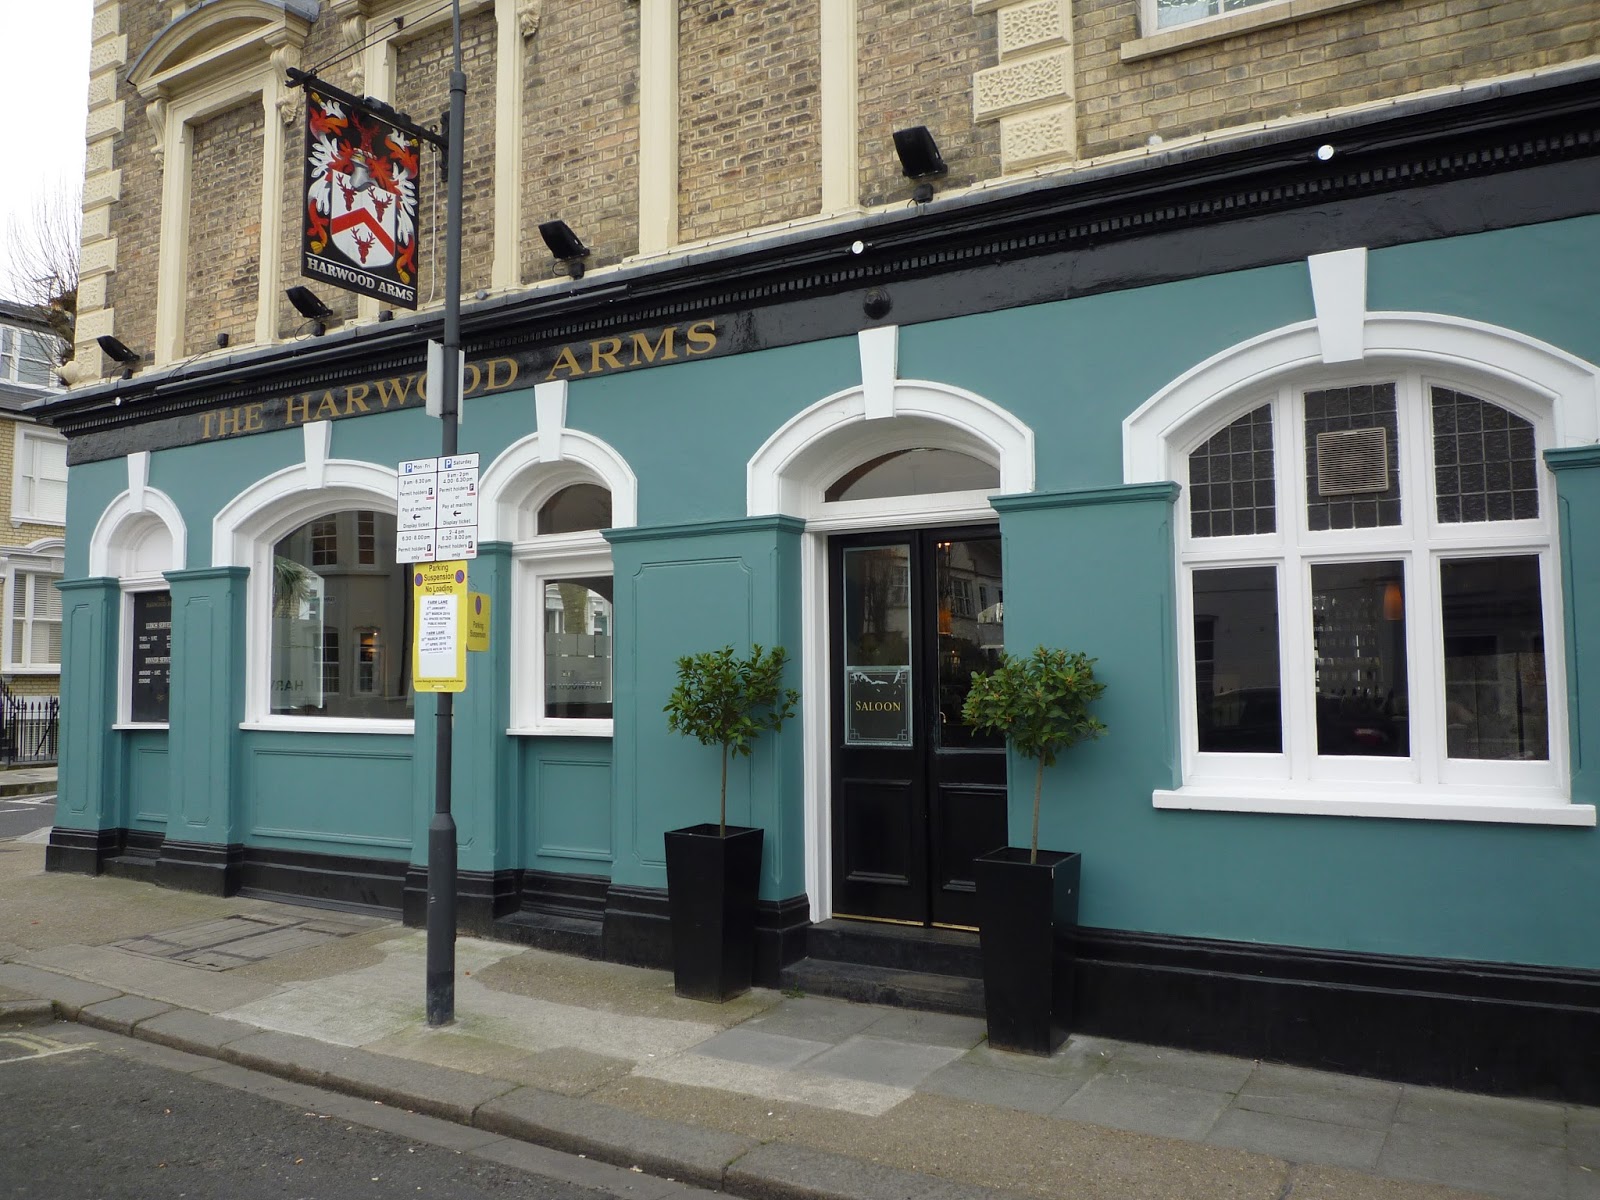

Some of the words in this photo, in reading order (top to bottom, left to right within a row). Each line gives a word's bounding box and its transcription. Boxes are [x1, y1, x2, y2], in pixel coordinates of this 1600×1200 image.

[307, 257, 375, 289] HARWOOD
[378, 281, 414, 301] ARMS
[199, 403, 264, 439] THE
[545, 320, 718, 381] ARMS
[424, 573, 454, 581] Suspension
[856, 701, 901, 711] SALOON
